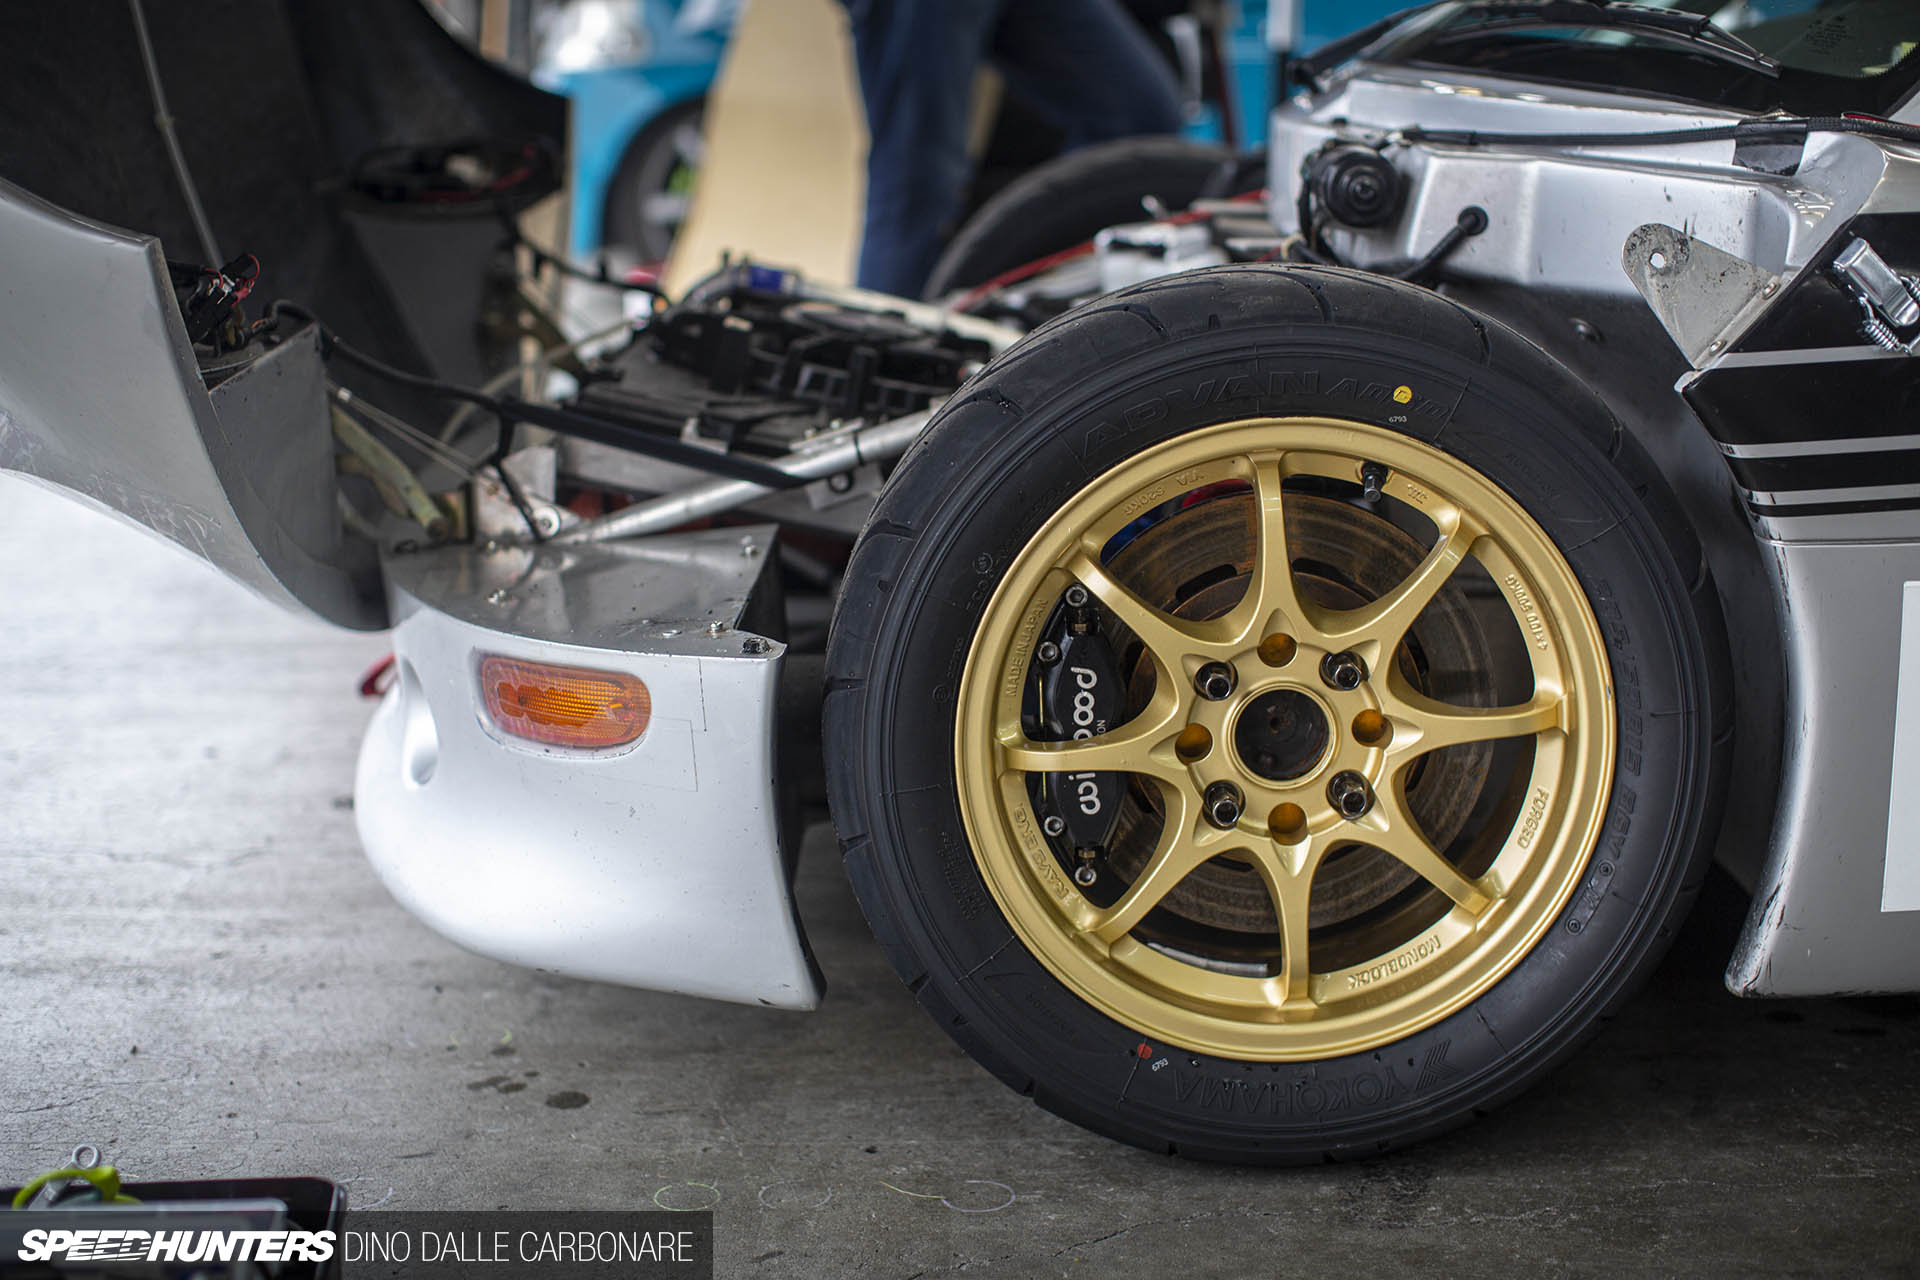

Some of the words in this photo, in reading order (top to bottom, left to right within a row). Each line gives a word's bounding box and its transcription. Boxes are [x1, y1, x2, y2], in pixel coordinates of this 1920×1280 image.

[1083, 370, 1321, 457] ADVAN
[1020, 599, 1049, 643] JAPAN
[1015, 640, 1030, 656] IN
[1005, 656, 1025, 697] MADE
[1069, 666, 1101, 815] wiood
[1517, 787, 1549, 850] FORGED
[1031, 848, 1070, 900] RAYS
[1347, 935, 1442, 990] MONOBLOCK
[1174, 1064, 1408, 1116] YOKOHAMA
